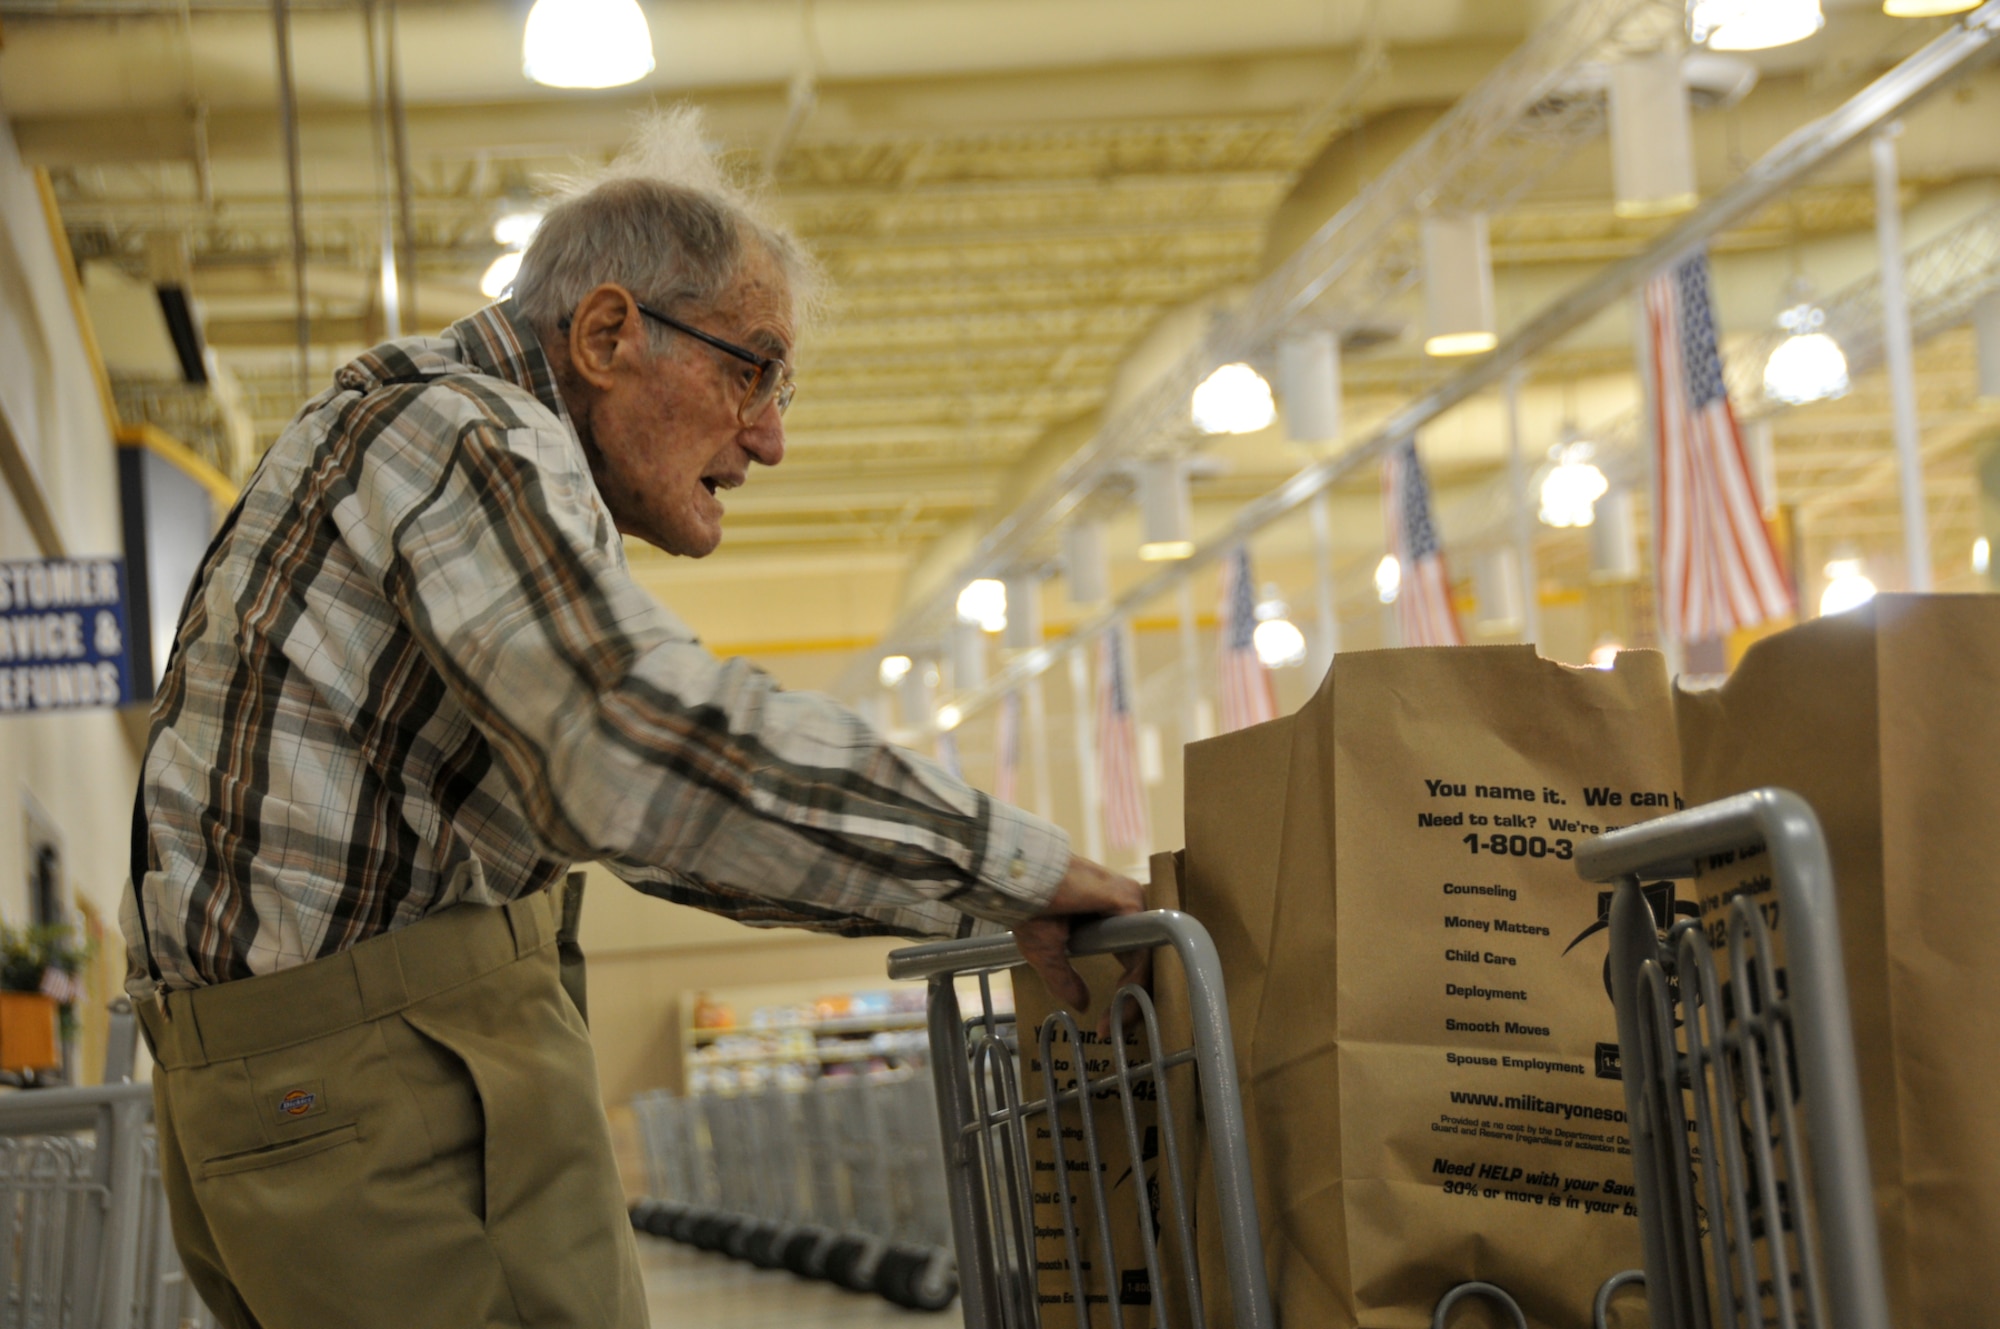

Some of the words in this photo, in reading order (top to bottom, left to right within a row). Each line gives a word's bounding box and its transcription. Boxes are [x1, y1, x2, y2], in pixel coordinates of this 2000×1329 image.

[94, 609, 122, 656] &
[1424, 779, 1466, 797] You
[1475, 785, 1535, 802] name
[1543, 787, 1566, 805] it.
[1583, 787, 1622, 807] We
[1630, 792, 1669, 807] can
[1418, 812, 1463, 827] Need
[1469, 813, 1488, 825] to
[1493, 814, 1537, 828] talk?
[1548, 818, 1599, 834] We're
[1463, 833, 1573, 860] 1-800-3
[1443, 883, 1517, 901] Counseling
[1444, 916, 1490, 932] Money
[1494, 919, 1550, 936] Matters
[1445, 949, 1480, 963] Child
[1484, 952, 1516, 966] Care
[1446, 983, 1527, 1001] Deployment
[1446, 1018, 1500, 1033] Smooth
[1505, 1022, 1550, 1036] Moves
[1054, 1059, 1069, 1071] to
[1446, 1052, 1497, 1066] Spouse
[1502, 1056, 1585, 1074] Employment
[1604, 1057, 1621, 1068] 1-8
[1037, 1128, 1083, 1141] Coueling
[1431, 1123, 1458, 1134] Guard
[1461, 1128, 1477, 1136] and
[1479, 1128, 1513, 1140] Reserve
[1564, 1140, 1573, 1148] of
[1575, 1141, 1615, 1153] activation
[1617, 1146, 1632, 1155] sta
[1440, 1114, 1479, 1127] Provided
[1481, 1120, 1490, 1128] at
[1506, 1123, 1525, 1132] cost
[1527, 1125, 1537, 1135] by
[1539, 1127, 1552, 1136] the
[1555, 1128, 1604, 1142] Department
[1617, 1136, 1630, 1145] De
[1432, 1158, 1475, 1177] Need
[1478, 1163, 1523, 1182] HELP
[1526, 1171, 1560, 1187] with
[1563, 1177, 1599, 1192] your
[1602, 1179, 1635, 1197] Savi
[1443, 1180, 1478, 1197] 30%
[1483, 1188, 1500, 1198] or
[1505, 1189, 1543, 1205] more
[1548, 1192, 1561, 1207] is
[1566, 1195, 1579, 1209] in
[1584, 1199, 1619, 1214] your
[1623, 1201, 1639, 1217] ba
[1036, 1259, 1062, 1270] mooth
[1037, 1294, 1061, 1306] pouse
